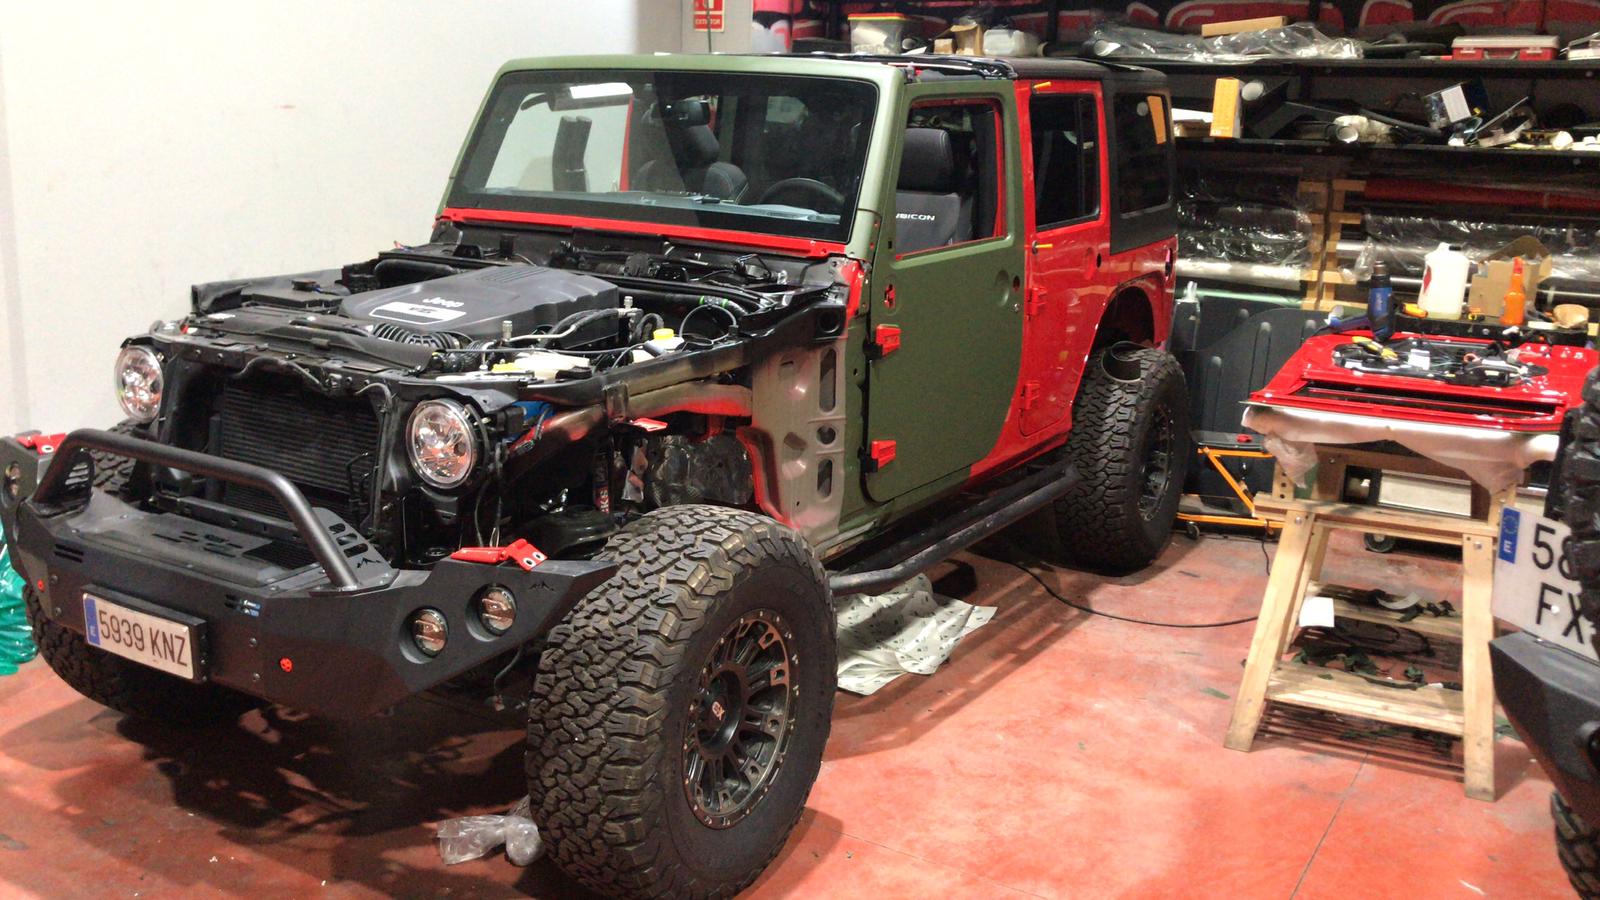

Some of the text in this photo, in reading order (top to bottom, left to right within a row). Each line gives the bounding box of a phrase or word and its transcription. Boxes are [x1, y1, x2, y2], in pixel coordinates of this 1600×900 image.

[422, 297, 465, 308] Jeep
[98, 610, 188, 667] 5939 KNZ
